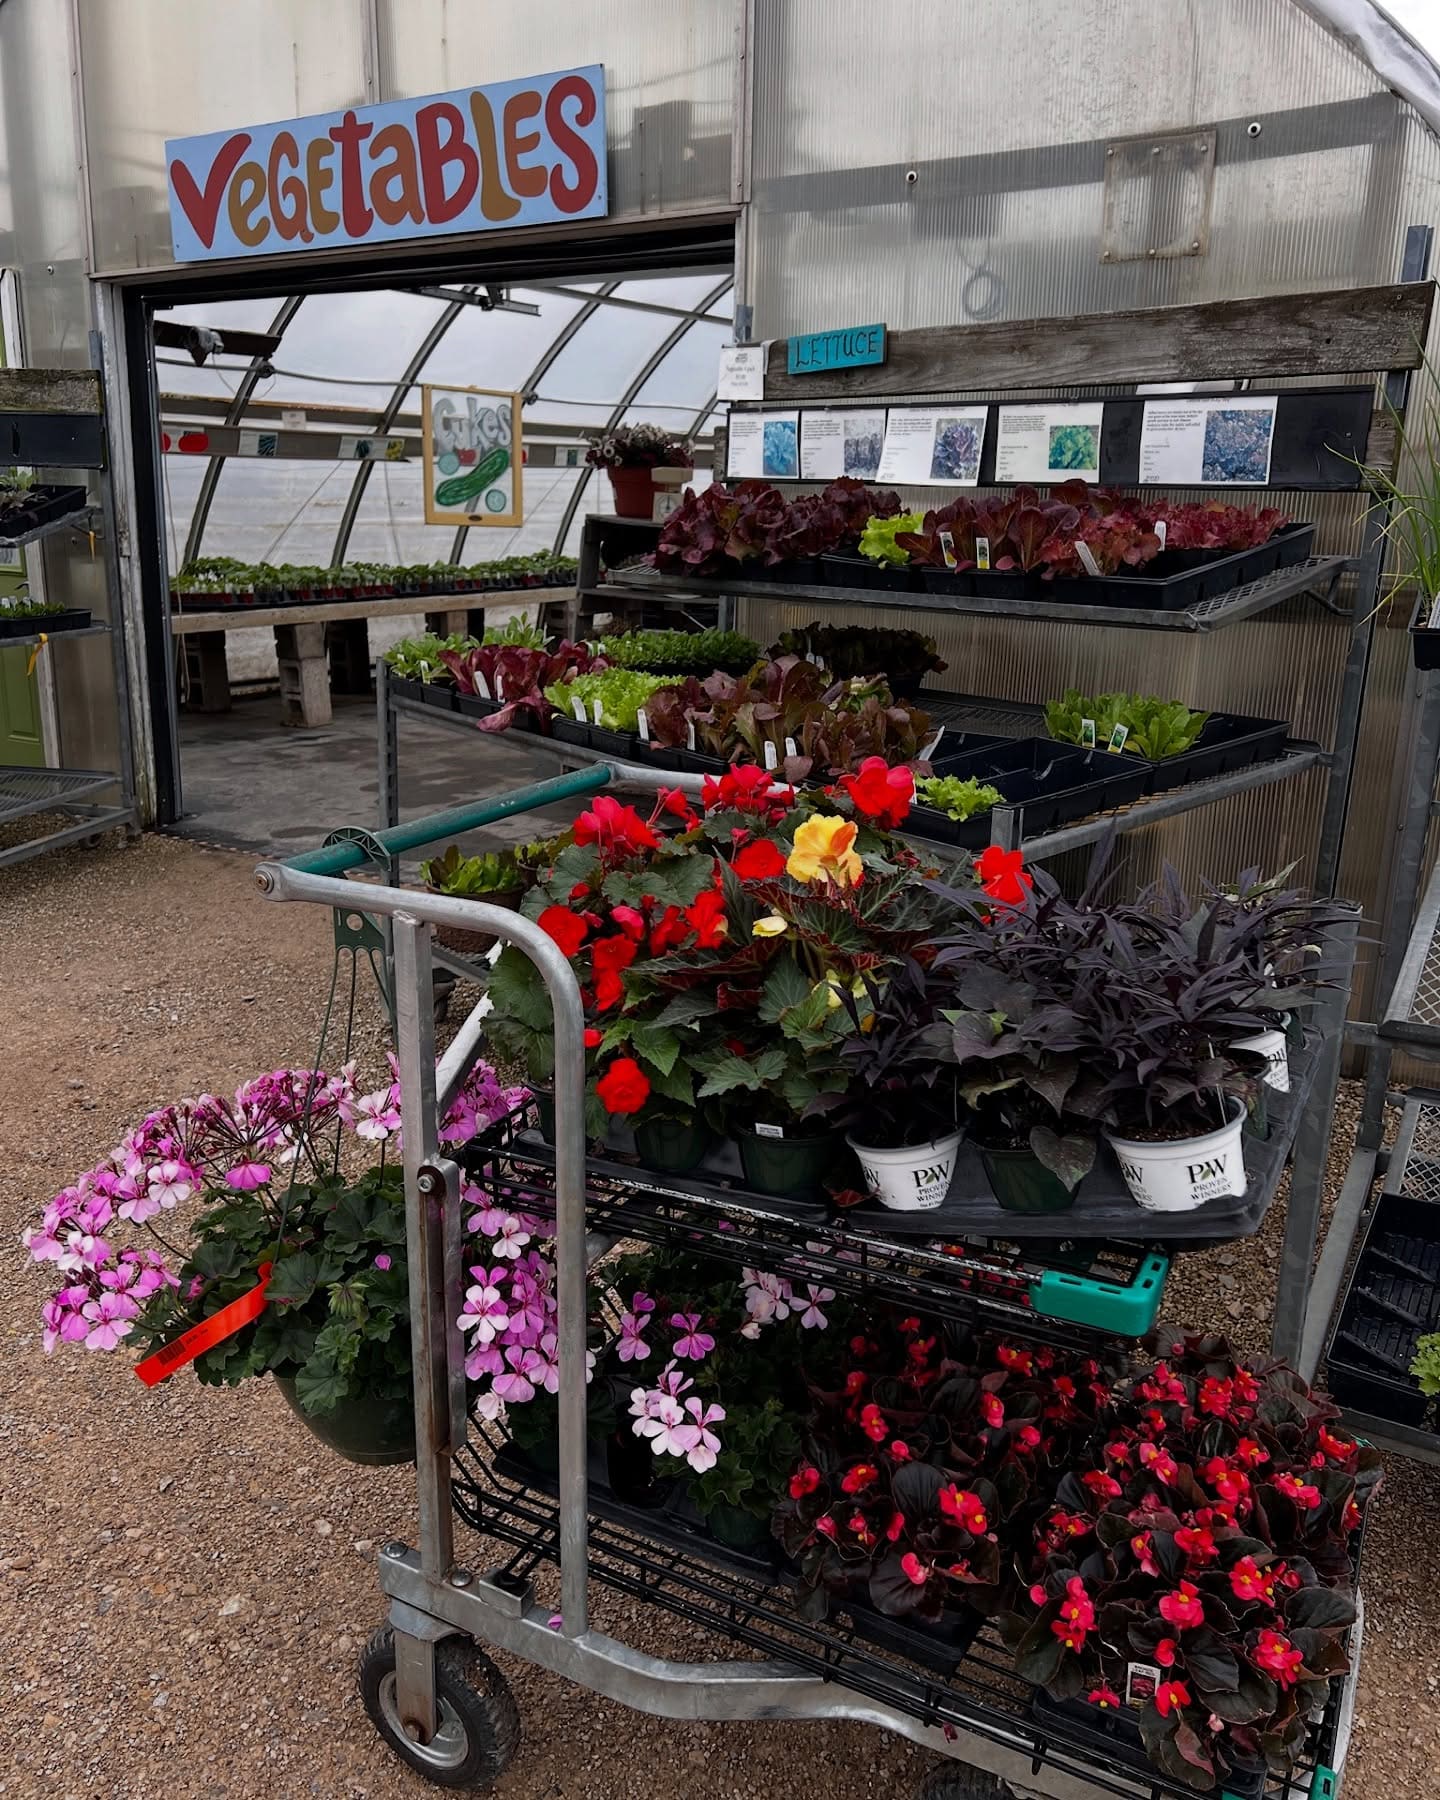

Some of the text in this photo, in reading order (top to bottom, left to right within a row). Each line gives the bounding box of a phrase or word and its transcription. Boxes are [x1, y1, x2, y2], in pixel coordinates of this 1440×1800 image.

[796, 331, 879, 367] LETTUCE
[912, 1160, 950, 1188] PW
[1185, 1153, 1228, 1185] PW
[1192, 1177, 1229, 1193] PROVEN
